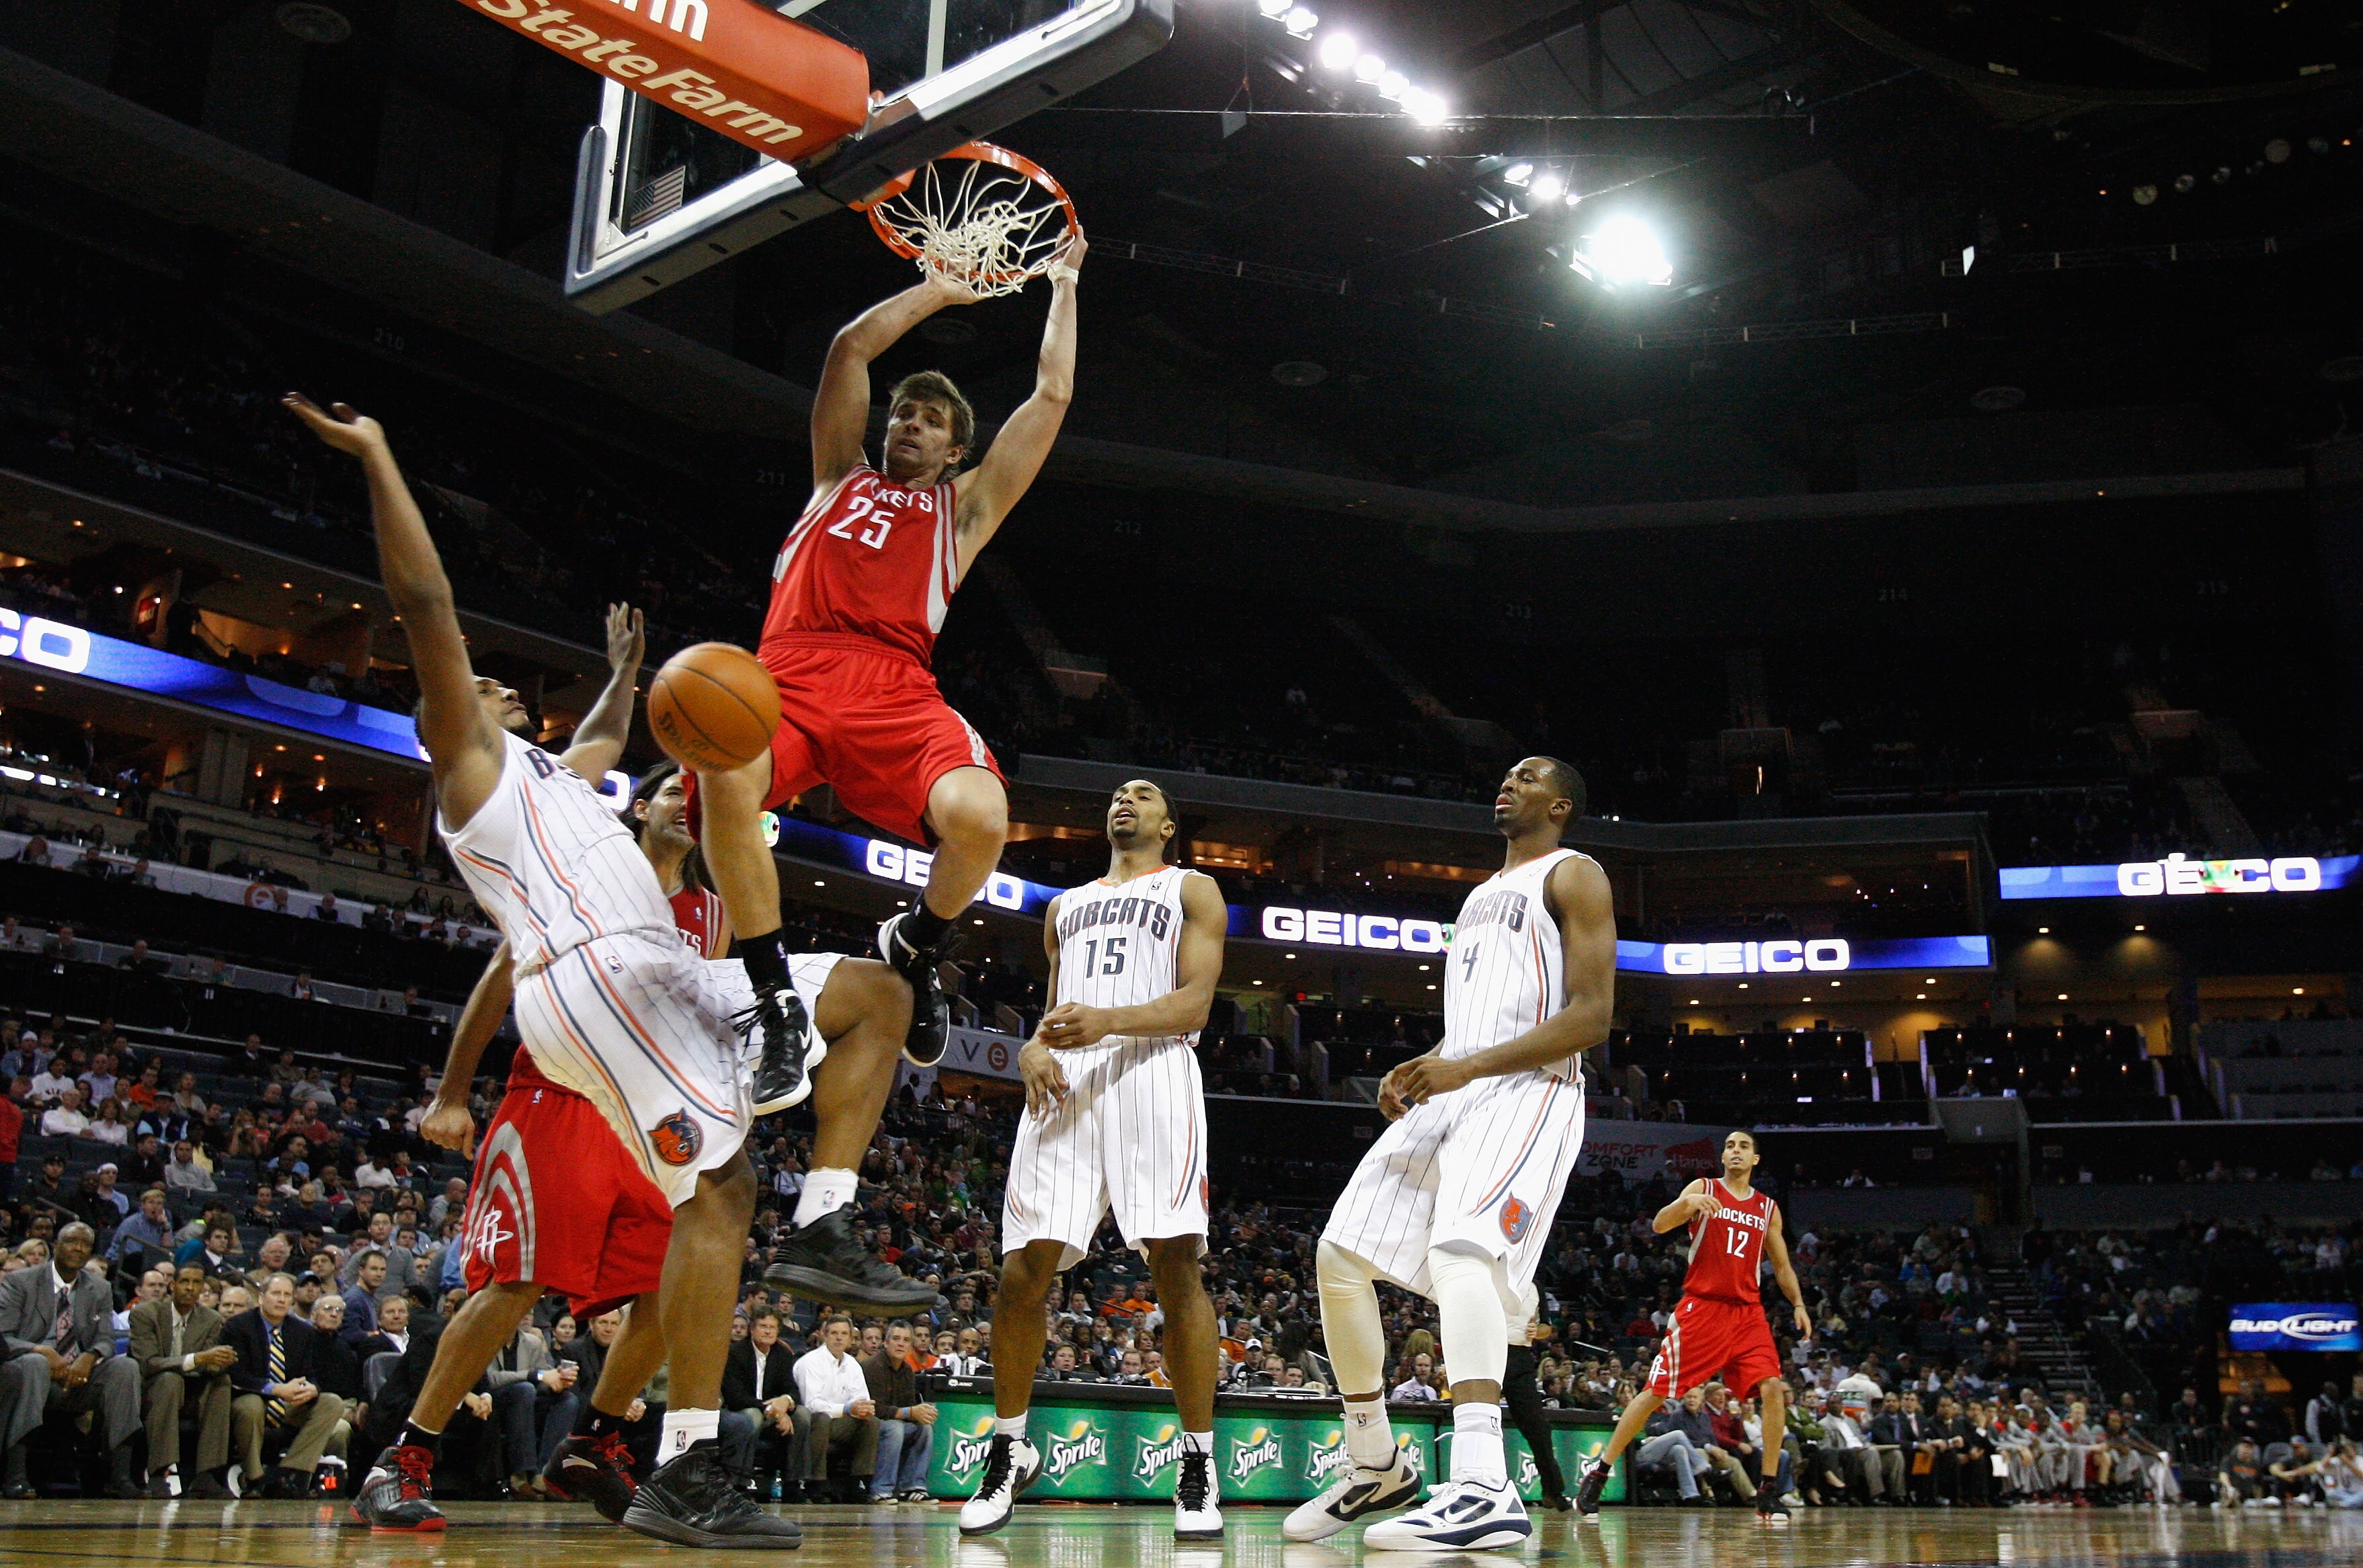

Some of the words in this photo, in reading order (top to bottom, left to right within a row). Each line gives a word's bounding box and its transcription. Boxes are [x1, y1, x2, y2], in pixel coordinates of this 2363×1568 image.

[641, 67, 804, 144] Farm
[828, 496, 895, 549] 25
[866, 839, 1023, 911] GEO
[1059, 898, 1171, 948] BOBCATS
[1263, 906, 1443, 953] GEICO
[1086, 938, 1127, 979] 15
[1462, 942, 1480, 983] 4
[1663, 938, 1850, 975] GEICO
[1581, 1141, 1658, 1156] OMFORT
[1587, 1153, 1638, 1169] ZONE
[1726, 1227, 1749, 1258] 12
[951, 1439, 992, 1473] Spri
[1049, 1432, 1100, 1475] Sprite
[1233, 1437, 1278, 1477] Sprite
